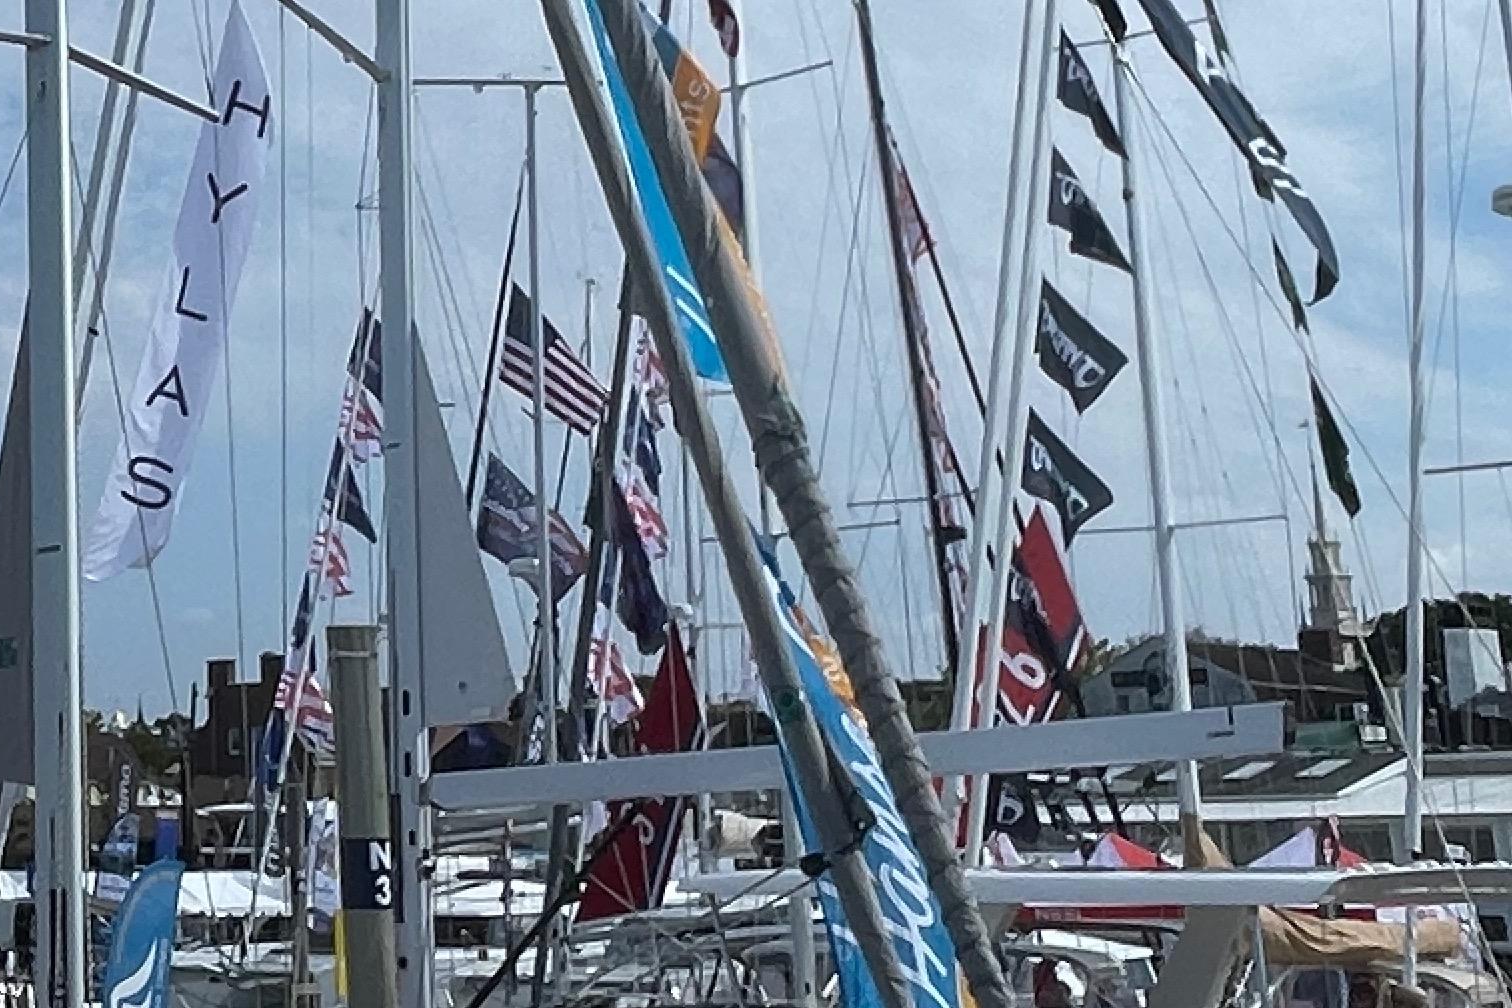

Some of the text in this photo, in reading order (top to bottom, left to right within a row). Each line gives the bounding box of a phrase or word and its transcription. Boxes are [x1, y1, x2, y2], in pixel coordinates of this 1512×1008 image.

[121, 79, 271, 510] HYLAS
[368, 841, 393, 871] N
[373, 876, 393, 907] 3
